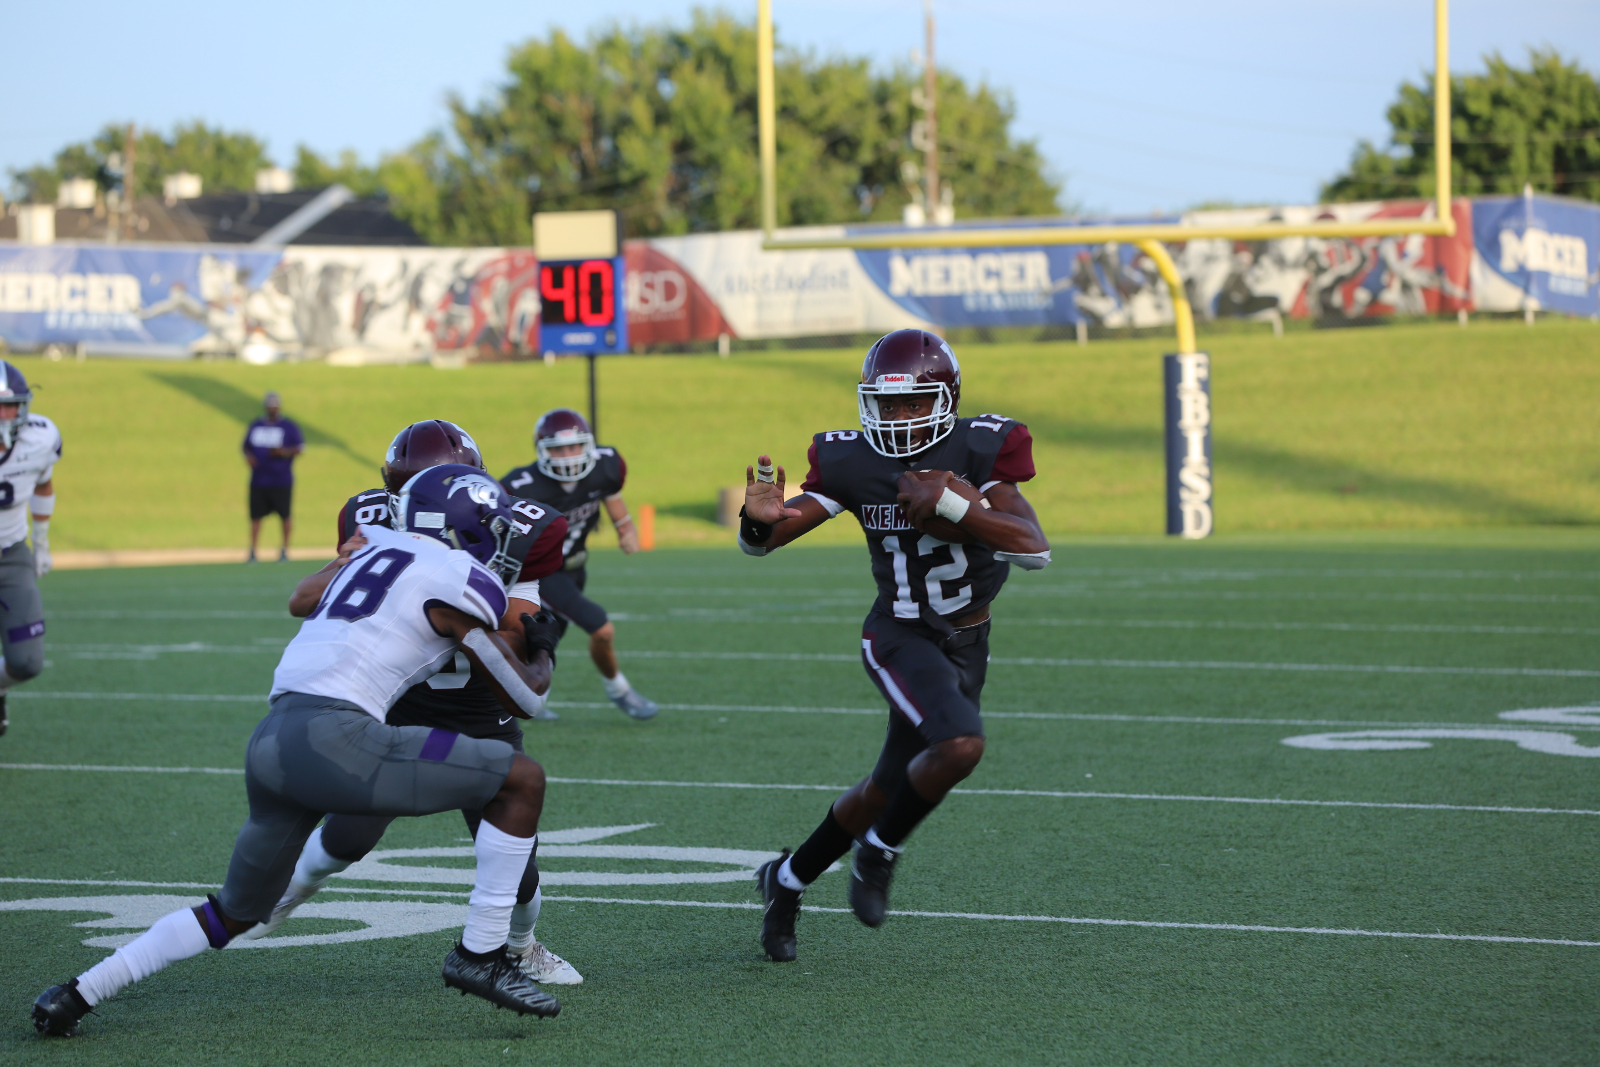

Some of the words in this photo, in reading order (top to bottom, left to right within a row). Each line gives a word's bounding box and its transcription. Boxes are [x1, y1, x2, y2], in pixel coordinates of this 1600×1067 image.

[888, 250, 1053, 297] MERCER
[1499, 228, 1588, 278] MCER
[0, 272, 141, 313] ERCER
[541, 260, 614, 327] 40
[1176, 353, 1213, 540] FBISD
[511, 471, 534, 490] 7
[355, 491, 389, 525] 16
[511, 500, 546, 536] 16
[862, 504, 914, 531] KEM
[881, 534, 973, 619] 12
